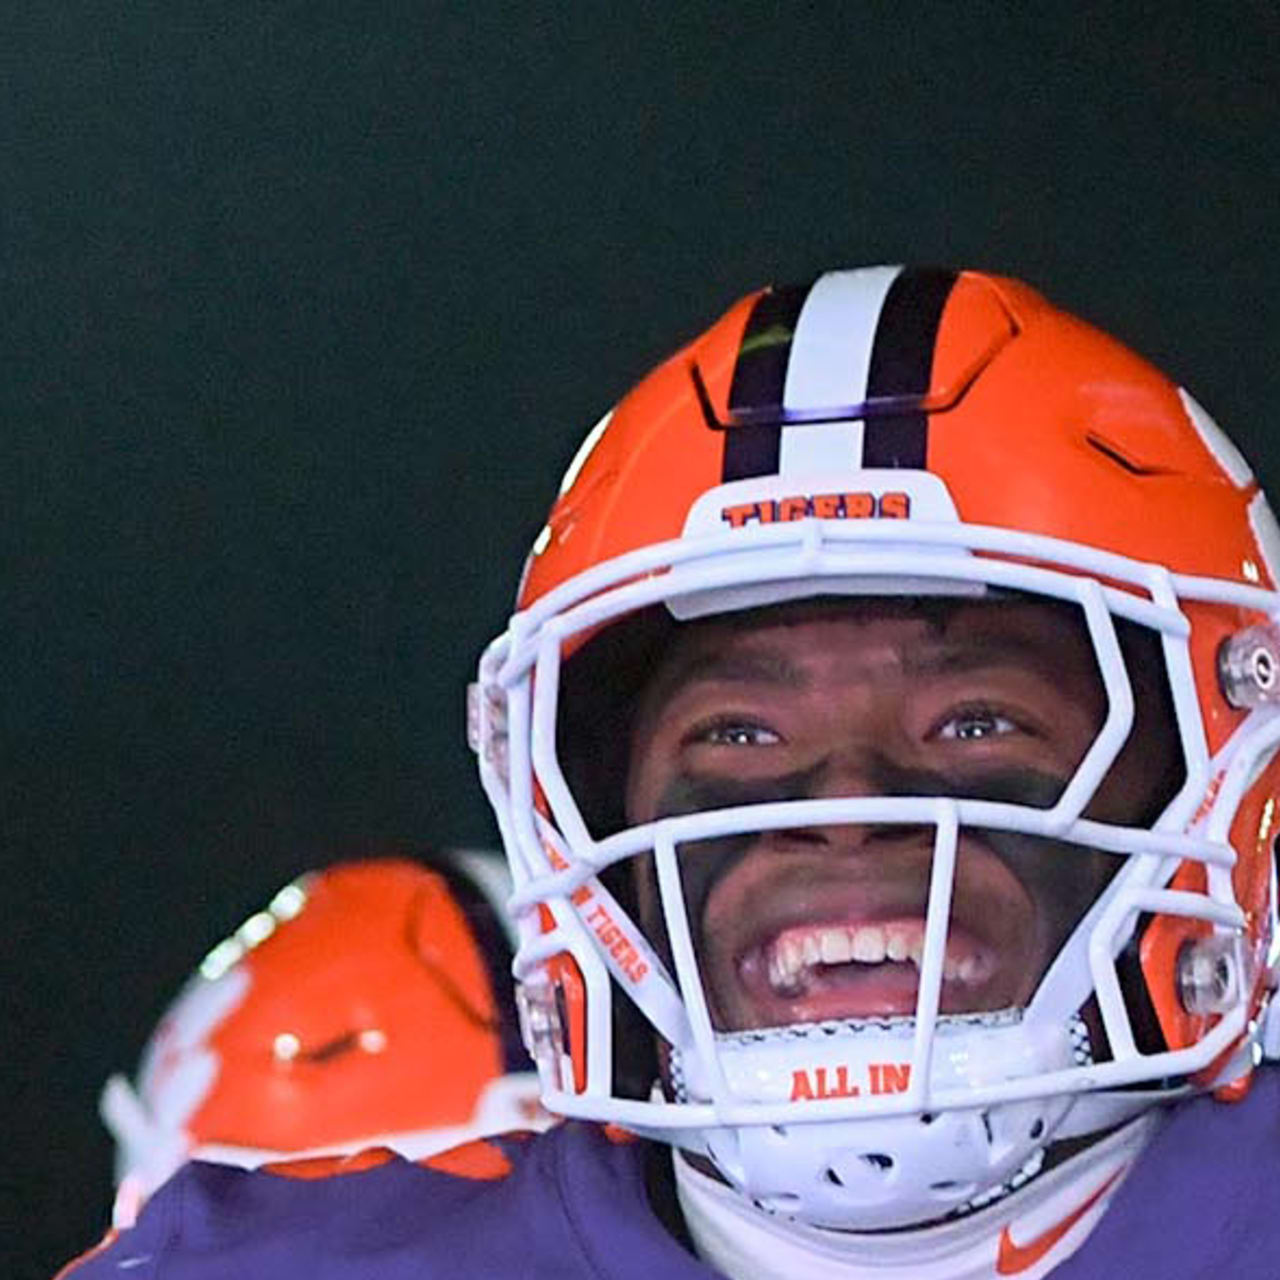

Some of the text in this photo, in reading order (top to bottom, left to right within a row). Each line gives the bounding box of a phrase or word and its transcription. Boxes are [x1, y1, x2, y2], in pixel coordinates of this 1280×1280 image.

[722, 491, 910, 529] TIGERS
[586, 903, 650, 984] TIGERS
[790, 1063, 911, 1102] ALL IN
